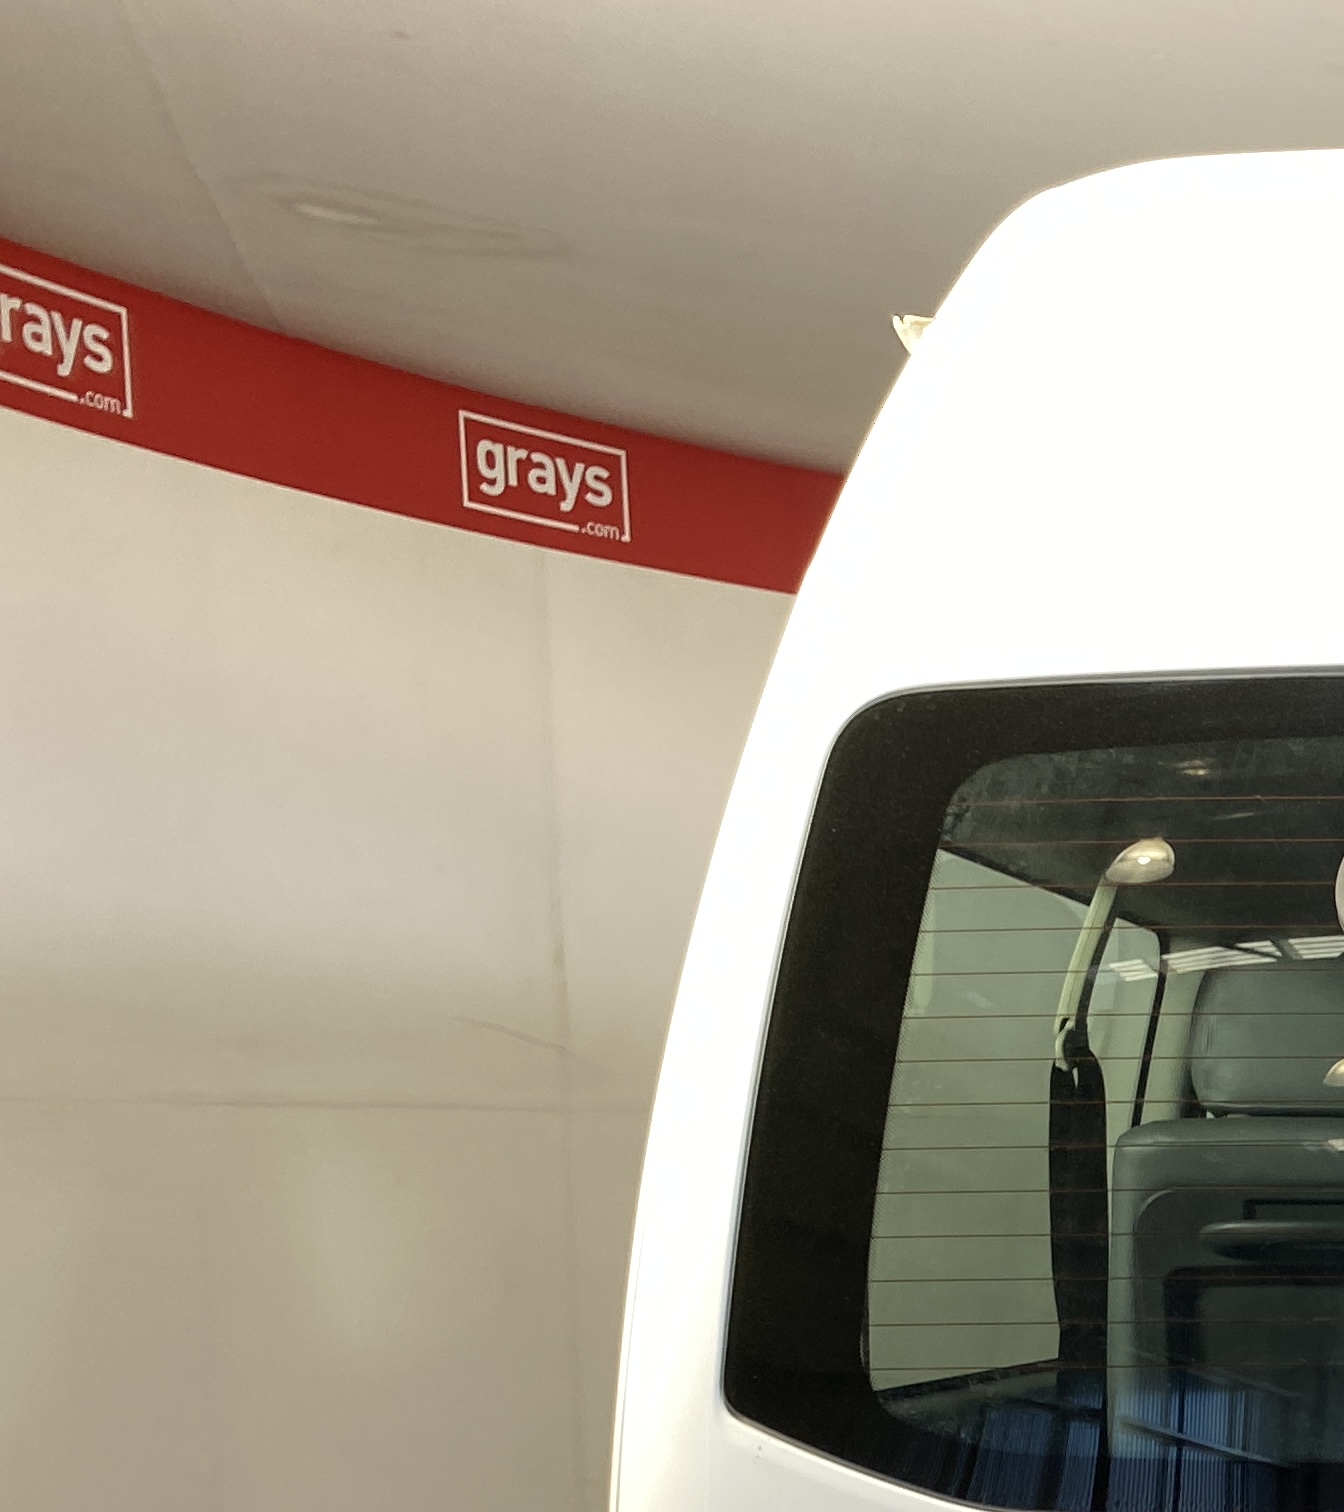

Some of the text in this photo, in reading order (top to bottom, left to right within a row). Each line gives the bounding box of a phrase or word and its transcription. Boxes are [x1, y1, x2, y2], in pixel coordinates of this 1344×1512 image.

[0, 293, 113, 377] rays
[476, 438, 613, 513] grays
[581, 521, 620, 540] .com
